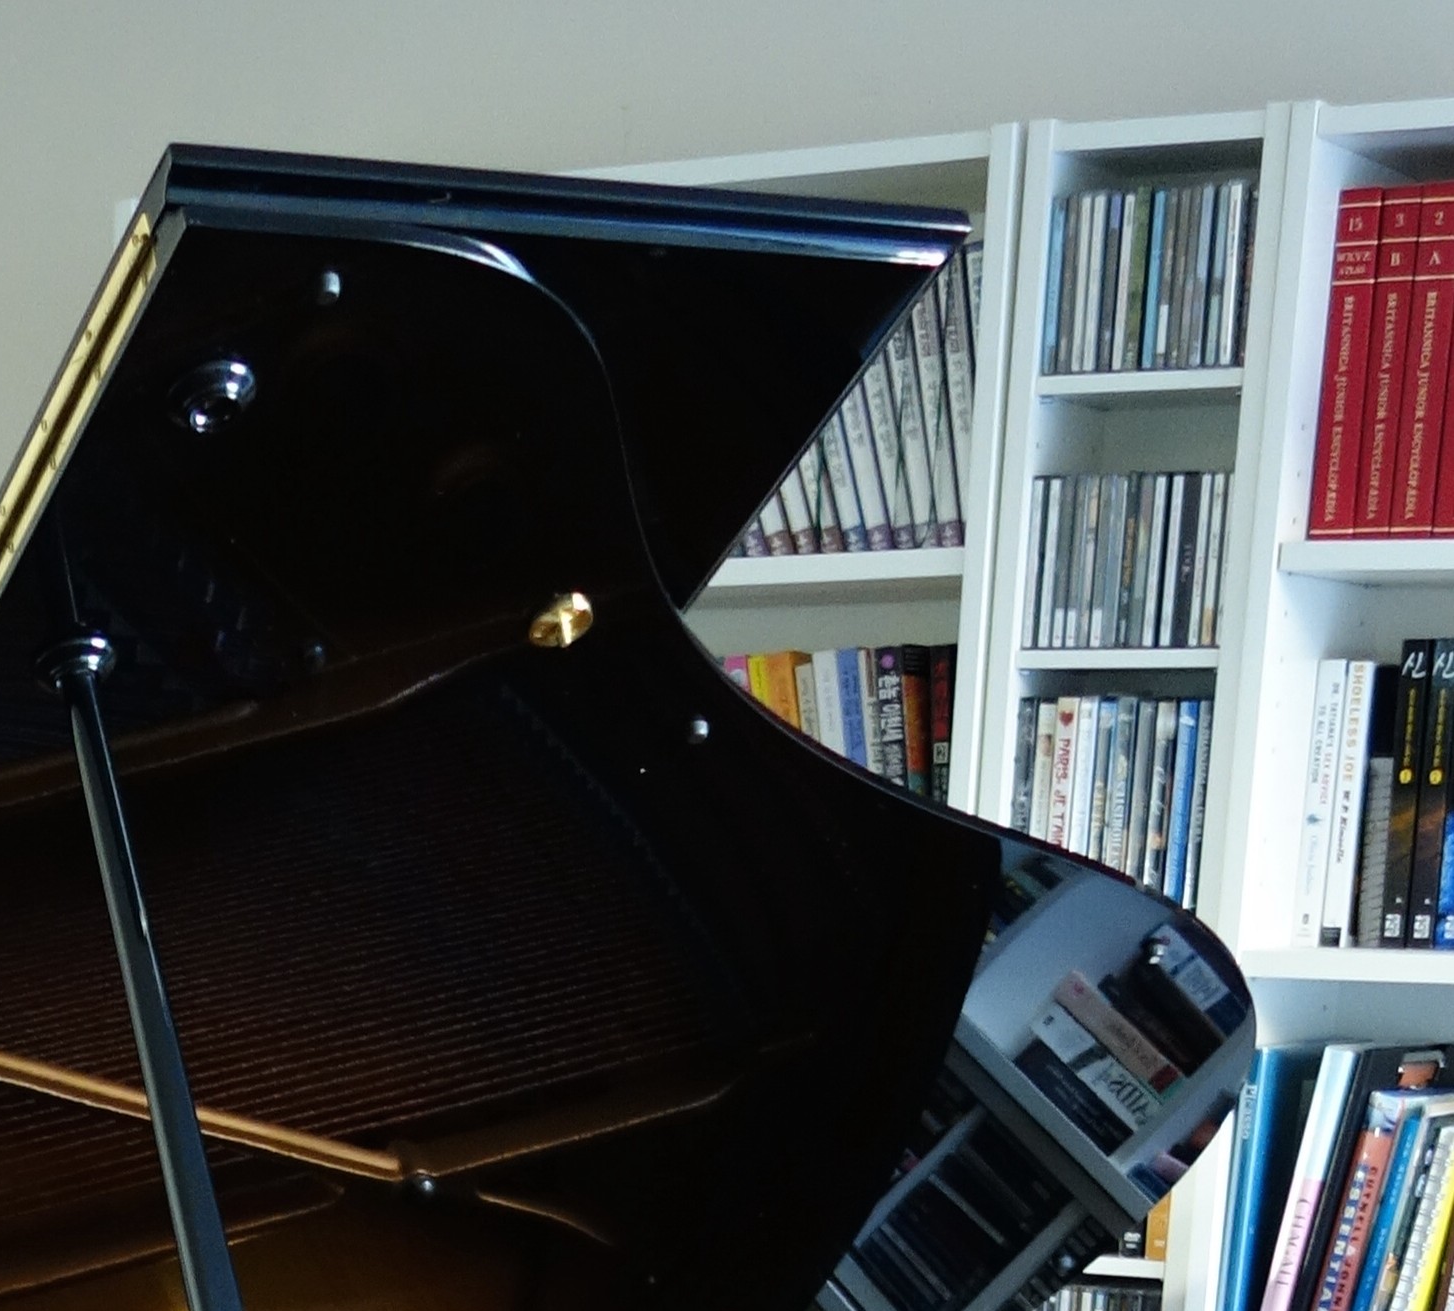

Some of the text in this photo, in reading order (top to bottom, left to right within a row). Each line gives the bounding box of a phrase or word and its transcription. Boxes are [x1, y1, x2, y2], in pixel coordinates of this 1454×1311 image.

[1348, 216, 1364, 232] 15
[1395, 213, 1405, 227] 3
[1434, 210, 1444, 226] 2
[1390, 252, 1402, 266] B
[1429, 251, 1441, 265] A
[1337, 295, 1356, 372] BRITANNICA
[1381, 292, 1398, 370] BRITANNICA
[1419, 291, 1438, 368] BRITANNICA
[1333, 374, 1347, 423] JUNIOR
[1375, 372, 1390, 420] JUNIOR
[1414, 370, 1430, 420] JUNIOR
[1345, 664, 1366, 748] SHOELESS
[1342, 755, 1355, 782] JOE
[1241, 1084, 1258, 1140] Picasso
[1349, 1166, 1379, 1241] CUTNELL
[1275, 1198, 1310, 1287] CHAGALL
